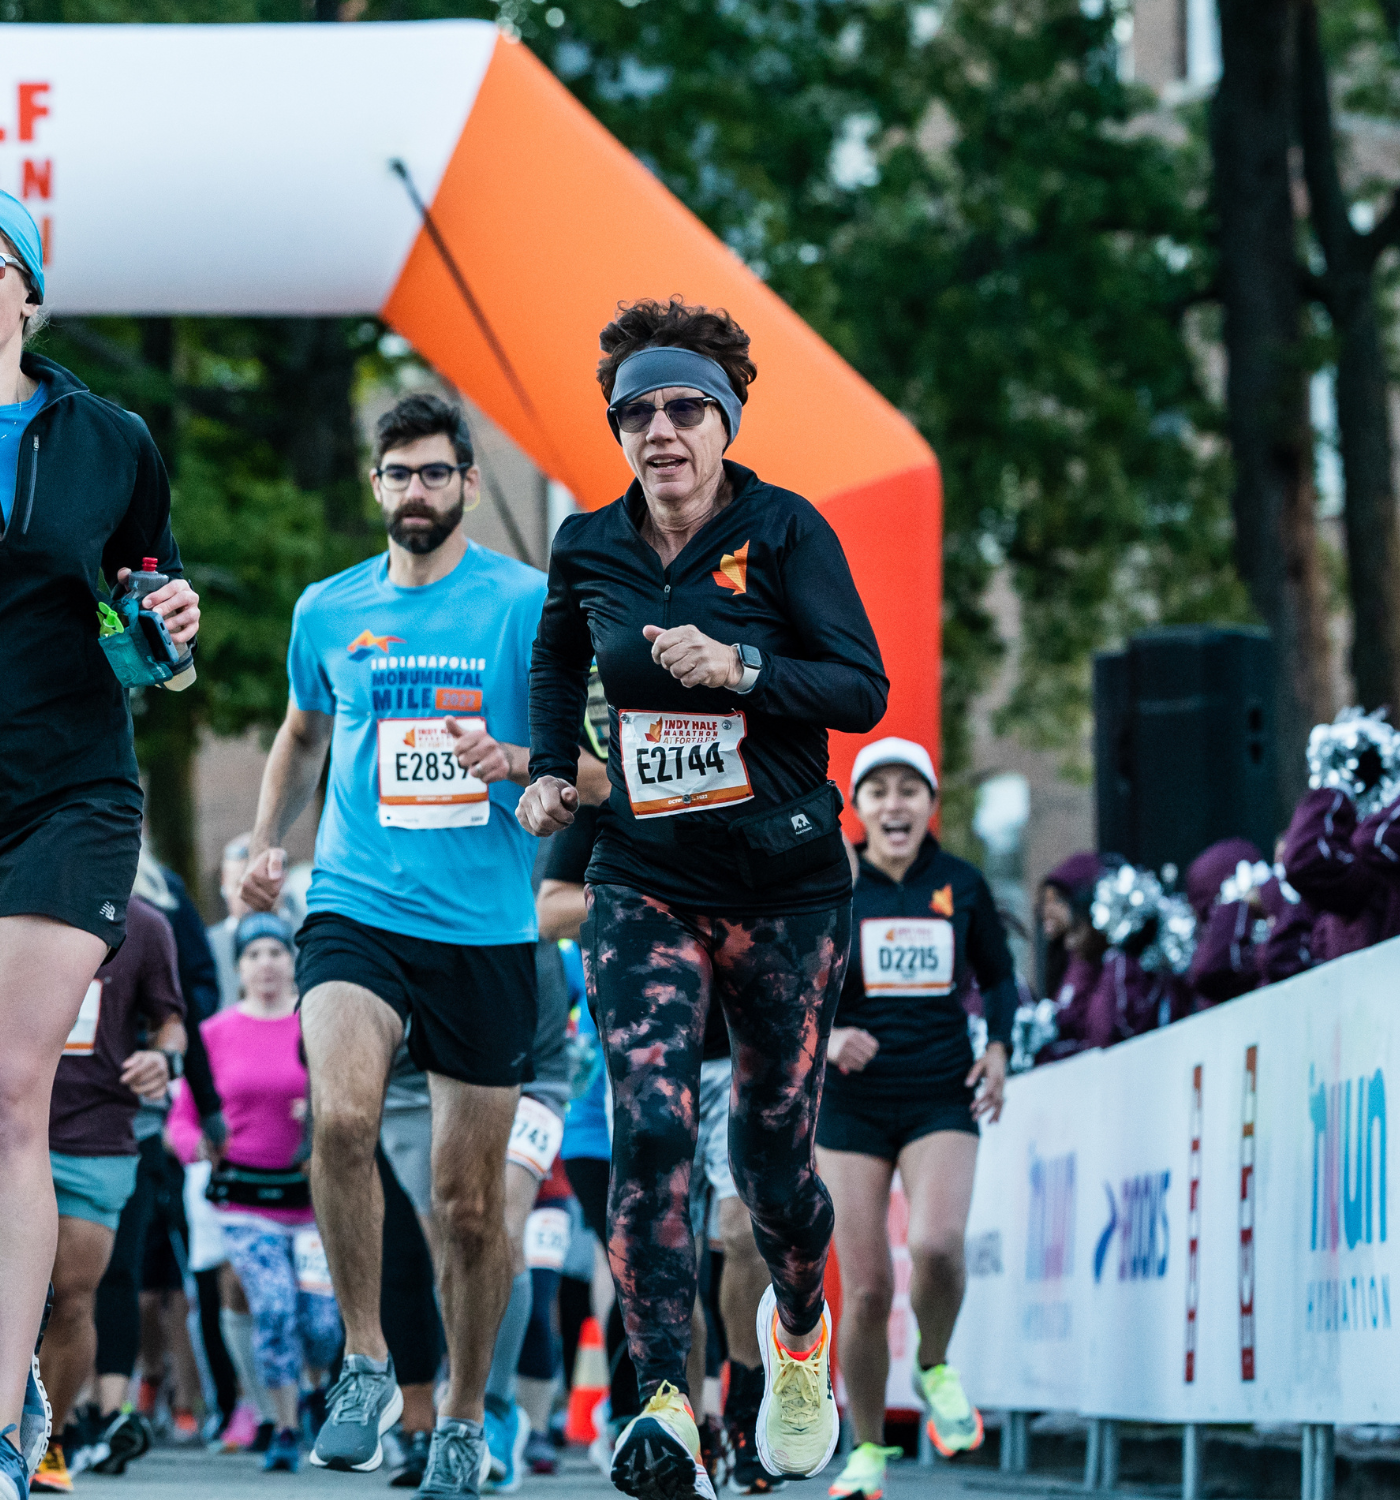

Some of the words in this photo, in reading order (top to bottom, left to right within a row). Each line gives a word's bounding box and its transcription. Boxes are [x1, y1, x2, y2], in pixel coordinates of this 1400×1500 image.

[371, 655, 486, 671] INDIANAPOLIS
[371, 670, 484, 687] MONUMENTAL
[372, 687, 432, 712] MILE
[441, 693, 477, 708] 2022
[664, 719, 690, 731] INDY
[692, 720, 718, 731] HALF
[663, 730, 718, 738] MARATHON
[663, 737, 674, 745] AT
[675, 737, 696, 745] FORT
[636, 741, 725, 785] E2744
[879, 945, 939, 972] D2215
